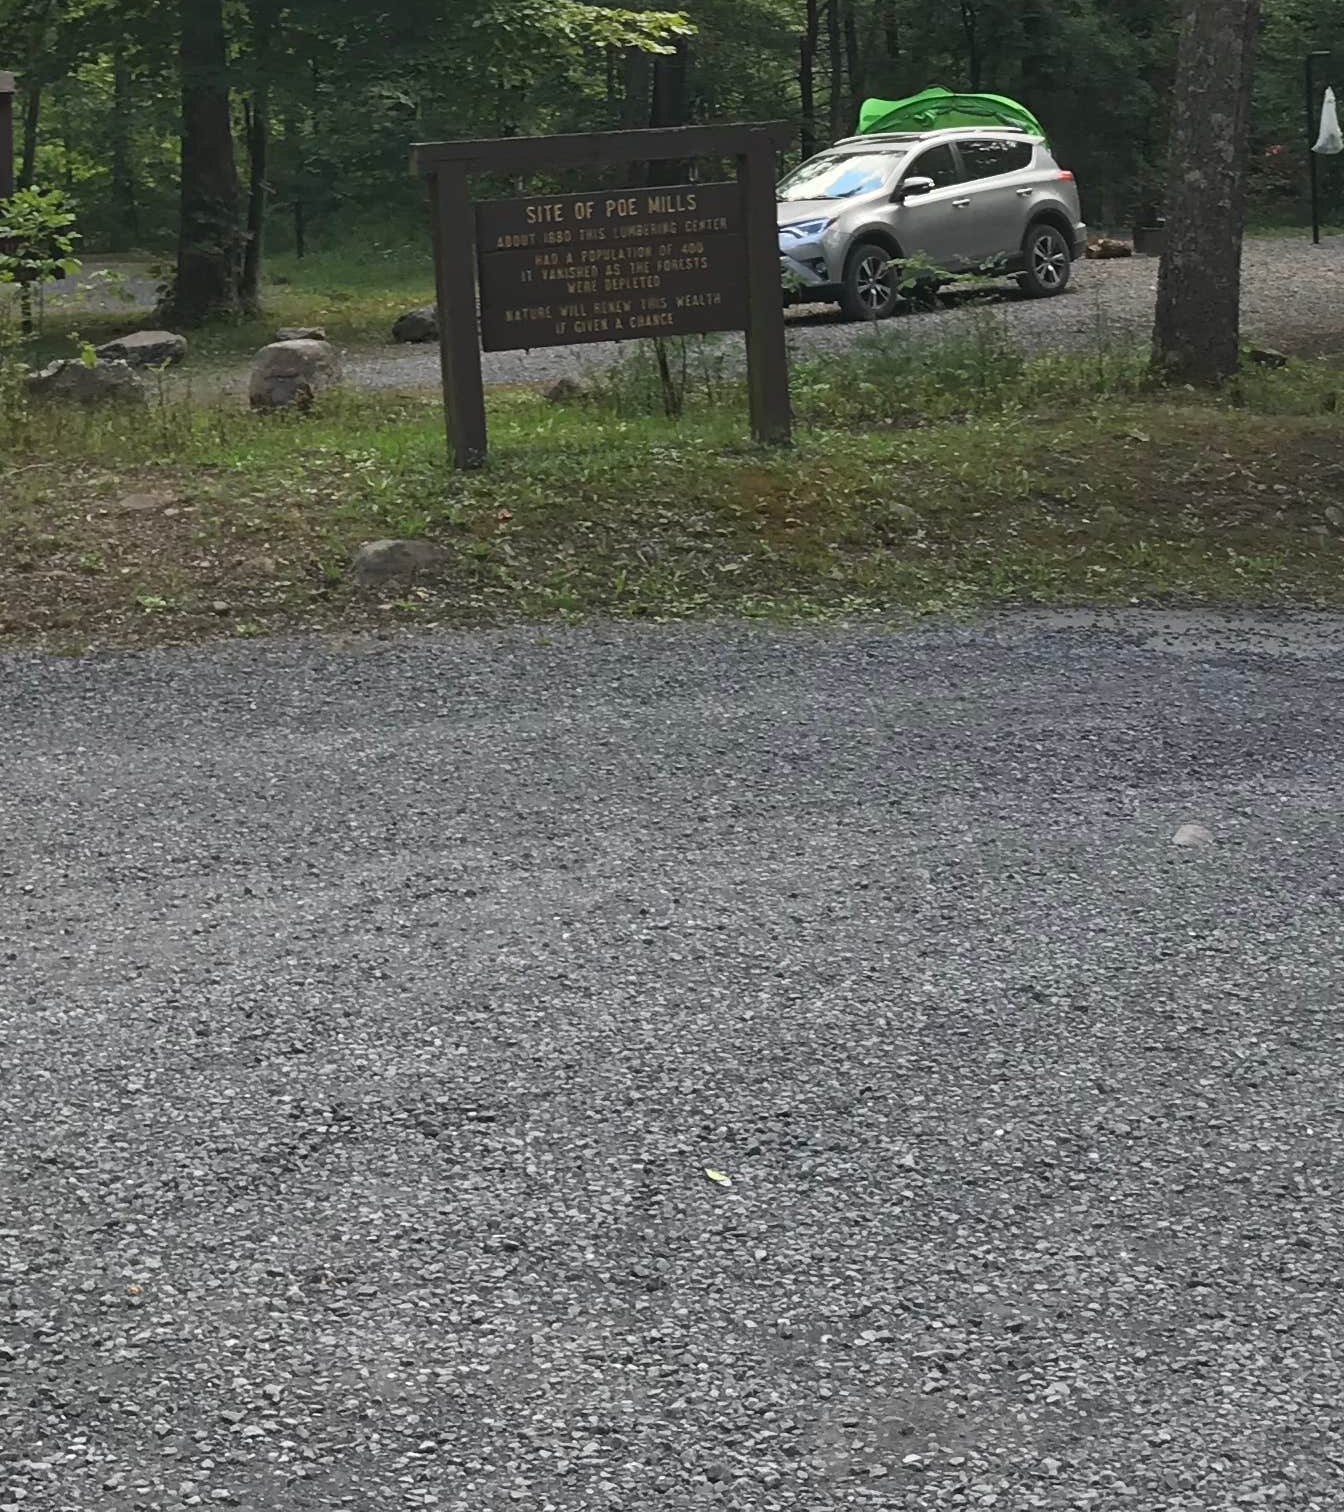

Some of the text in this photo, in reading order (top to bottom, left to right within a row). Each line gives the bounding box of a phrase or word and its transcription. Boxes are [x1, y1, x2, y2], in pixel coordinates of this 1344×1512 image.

[526, 194, 697, 224] SITE OF POE MILLS
[497, 233, 536, 248] ABOUT
[579, 227, 607, 241] THIS
[613, 223, 679, 239] LUMBERING
[685, 217, 728, 233] CENTER
[566, 252, 574, 265] A
[581, 247, 652, 263] POPULATION
[658, 244, 673, 257] OF
[521, 257, 708, 282] IT VANISHED AS THE FORESTS
[567, 275, 661, 294] WERE DEPLETED
[505, 306, 552, 322] NATURE
[560, 303, 587, 317] WILL
[640, 297, 667, 310] THIS
[676, 293, 721, 308] WEALTH
[574, 318, 609, 333] GIVEN
[615, 317, 624, 330] A
[630, 313, 674, 328] CHANCE
